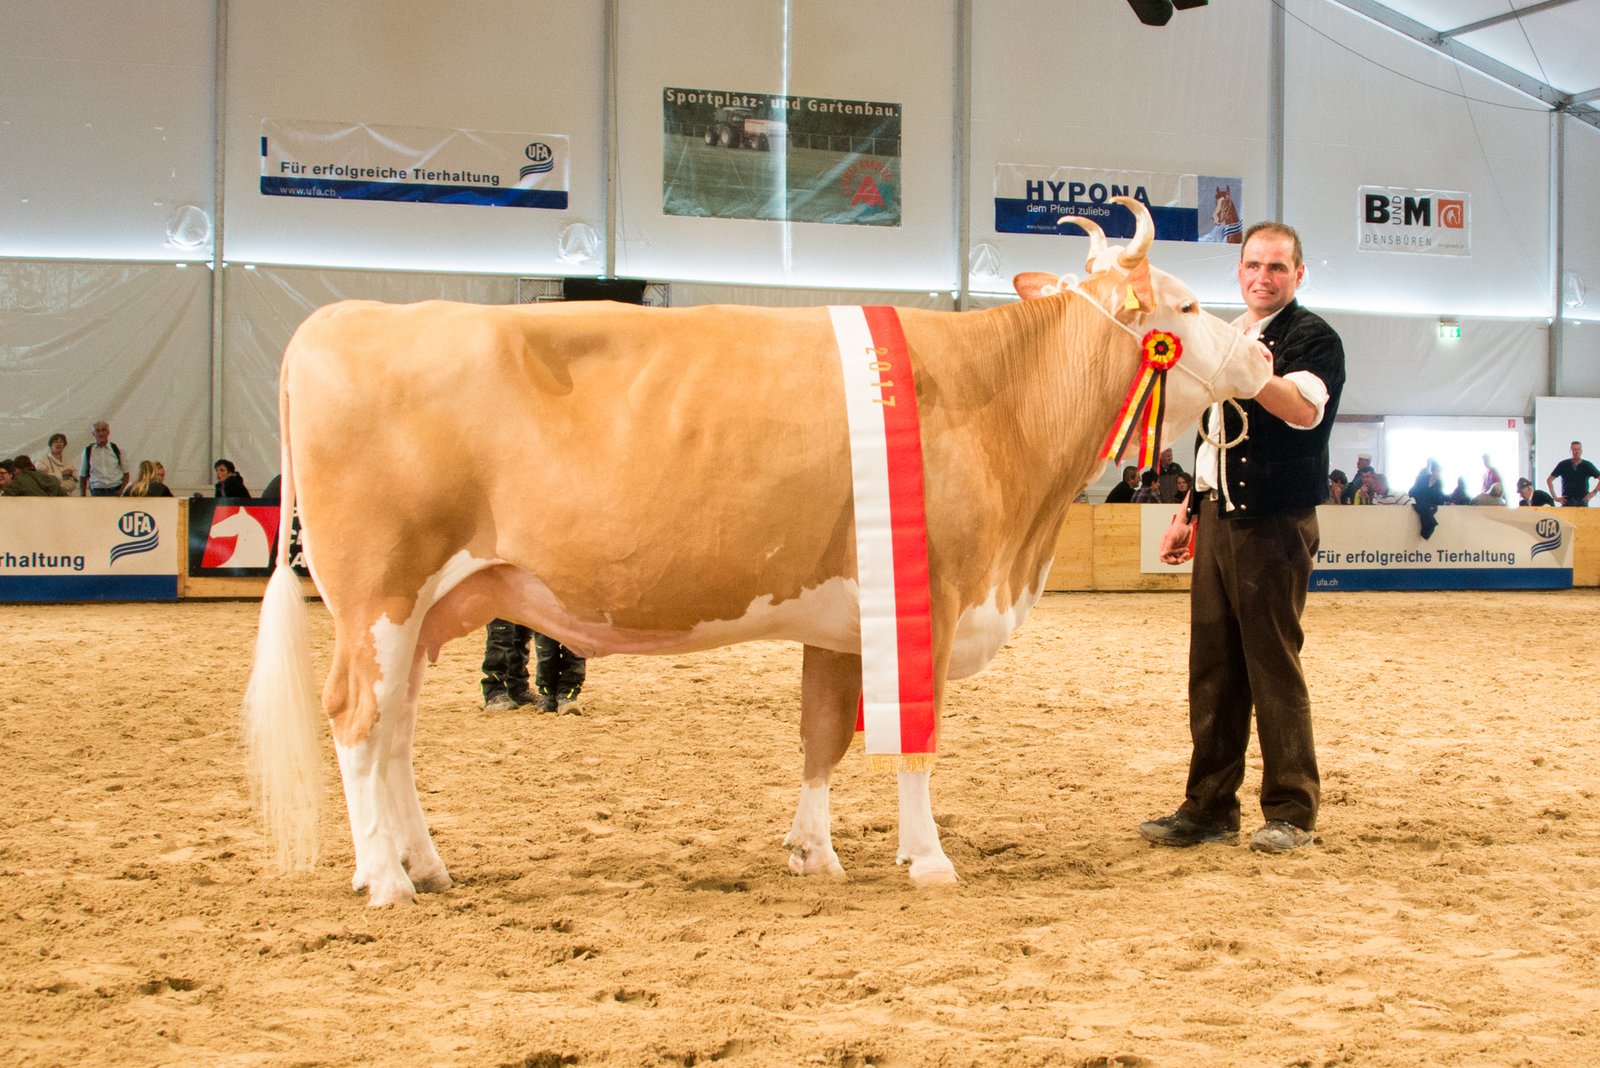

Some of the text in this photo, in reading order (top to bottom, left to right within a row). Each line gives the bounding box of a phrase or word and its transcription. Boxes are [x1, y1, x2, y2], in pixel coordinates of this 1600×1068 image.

[666, 89, 899, 117] Sportplatz- und Gartenbau.
[527, 143, 550, 161] UFA
[280, 161, 500, 185] Für erfolgreiche Tierhaltung
[279, 186, 336, 197] www.ufa.ch
[1026, 180, 1152, 207] HYPONA
[1026, 203, 1110, 217] dem Pferd zuliebe
[1365, 234, 1432, 247] DENSBÜREN
[865, 346, 896, 407] 2017
[122, 512, 151, 536] UFA
[1538, 520, 1558, 537] UFA
[1317, 549, 1516, 566] Für erfolgreiche Tierhaltung
[1316, 578, 1339, 587] ufa.ch
